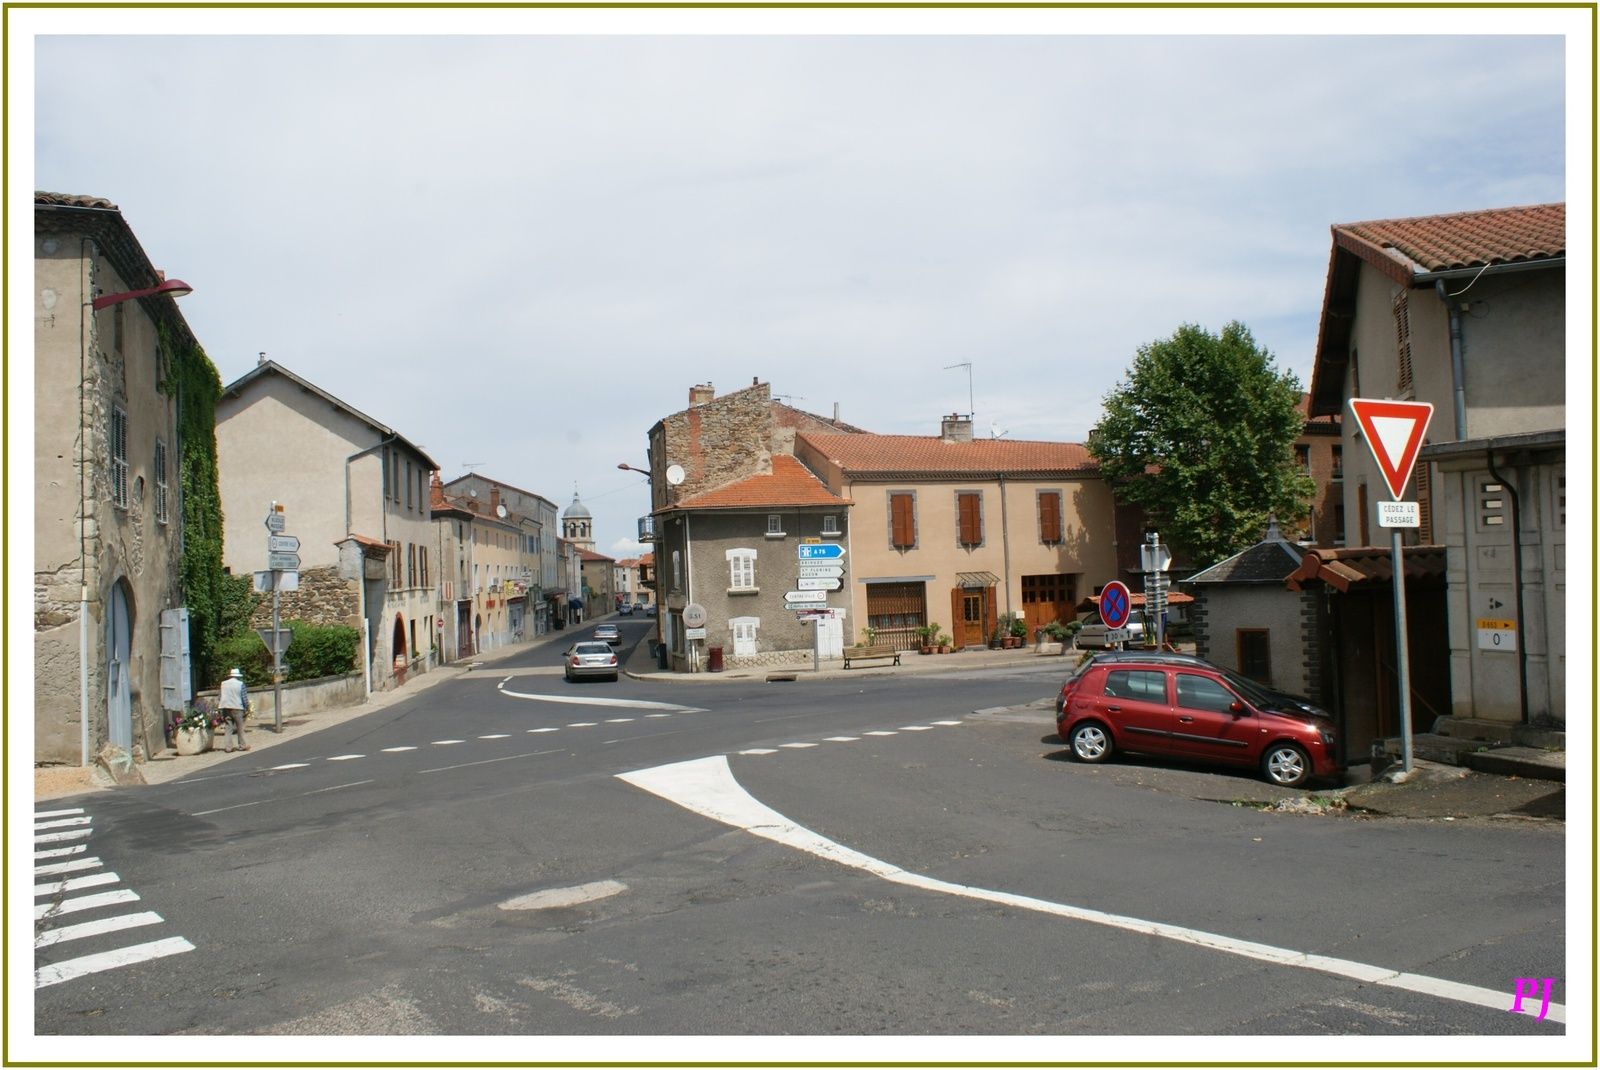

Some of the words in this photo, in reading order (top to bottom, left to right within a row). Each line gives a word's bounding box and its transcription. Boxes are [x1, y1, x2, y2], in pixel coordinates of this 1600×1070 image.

[1384, 504, 1403, 513] CÉDEZ
[1407, 505, 1415, 513] LE
[1386, 516, 1414, 524] PASSAGE
